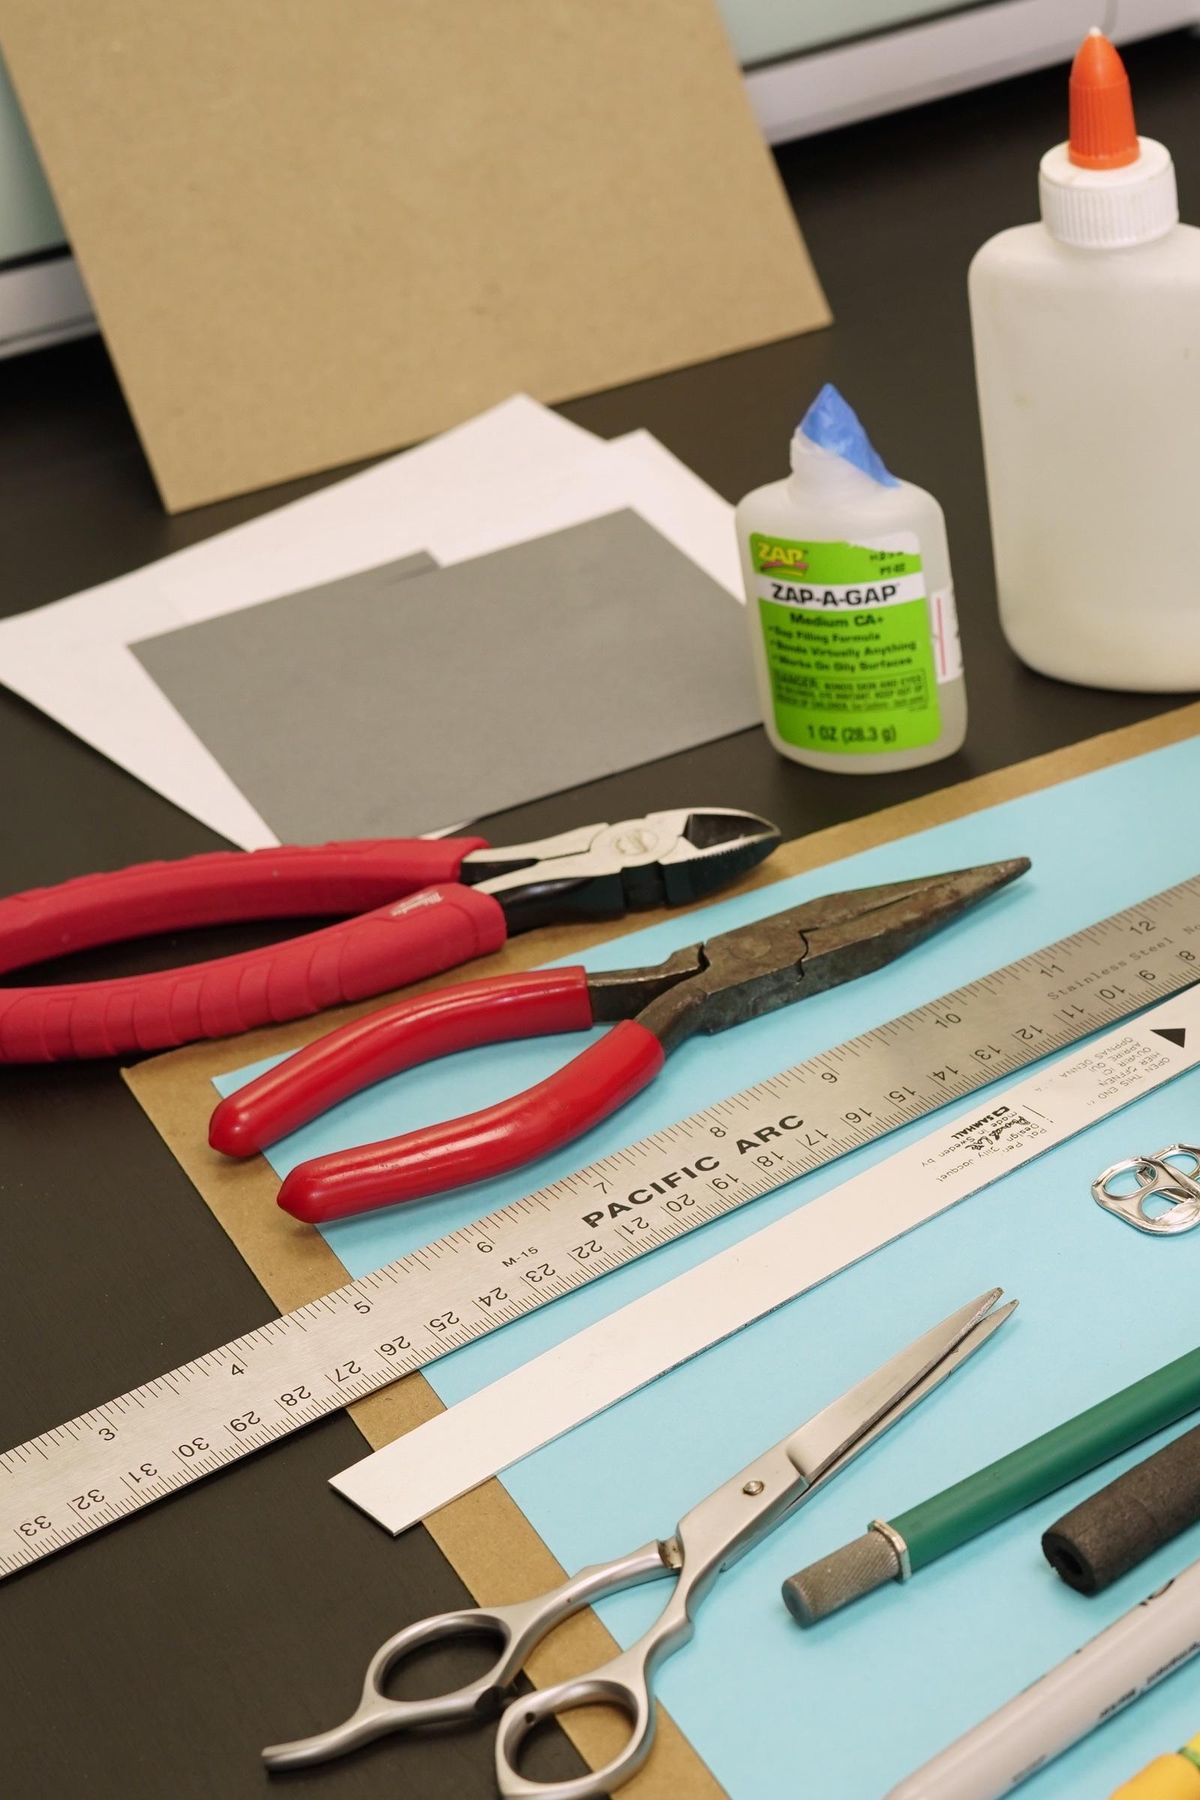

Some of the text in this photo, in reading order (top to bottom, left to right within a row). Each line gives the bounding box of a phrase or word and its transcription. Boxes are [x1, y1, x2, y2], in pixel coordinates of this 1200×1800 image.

[771, 583, 897, 607] ZAP-A-GAP
[790, 612, 848, 627] Medium
[832, 633, 880, 642] Formula
[865, 642, 916, 656] Anything
[808, 725, 815, 738] 1
[1179, 950, 1196, 962] 8
[1047, 959, 1128, 1000] Stainless
[1129, 936, 1174, 961] Steel
[1099, 984, 1126, 1000] 10
[1061, 1003, 1085, 1019] 11
[1015, 1024, 1043, 1041] 12
[975, 1044, 1002, 1062] 13
[1139, 1052, 1161, 1066] HIER
[933, 1065, 959, 1081] 14
[1098, 1057, 1170, 1100] OPEN THIS END
[889, 1086, 916, 1104] 15
[845, 1107, 872, 1124] 16
[991, 1111, 1017, 1127] made
[951, 1115, 994, 1139] SAMHALL
[1006, 1123, 1039, 1142] Design
[808, 1129, 829, 1146] 17
[939, 1136, 975, 1157] Sweden
[757, 1151, 784, 1168] 18
[921, 1158, 935, 1167] by
[98, 1427, 116, 1441] 3
[230, 1363, 245, 1376] 4
[354, 1301, 371, 1315] 5
[477, 1241, 493, 1254] 6
[594, 1181, 609, 1195] 7
[710, 1126, 727, 1138] 8
[821, 1072, 838, 1084] 9
[935, 1012, 962, 1029] 10
[1039, 964, 1065, 978] 11
[1130, 920, 1157, 936] 12
[581, 1115, 805, 1228] PACIFIC ARC
[712, 1173, 739, 1191] 19
[666, 1193, 696, 1213] 20
[623, 1216, 650, 1235] 21
[501, 1246, 539, 1268] M-15
[573, 1240, 603, 1260] 22
[526, 1263, 556, 1283] 23
[478, 1287, 508, 1307] 24
[429, 1311, 460, 1333] 25
[380, 1335, 411, 1357] 26
[335, 1360, 362, 1383] 27
[280, 1385, 312, 1407] 28
[230, 1411, 261, 1433] 29
[178, 1437, 210, 1459] 30
[132, 1462, 158, 1484] 31
[72, 1489, 105, 1511] 32
[20, 1515, 52, 1537] 33
